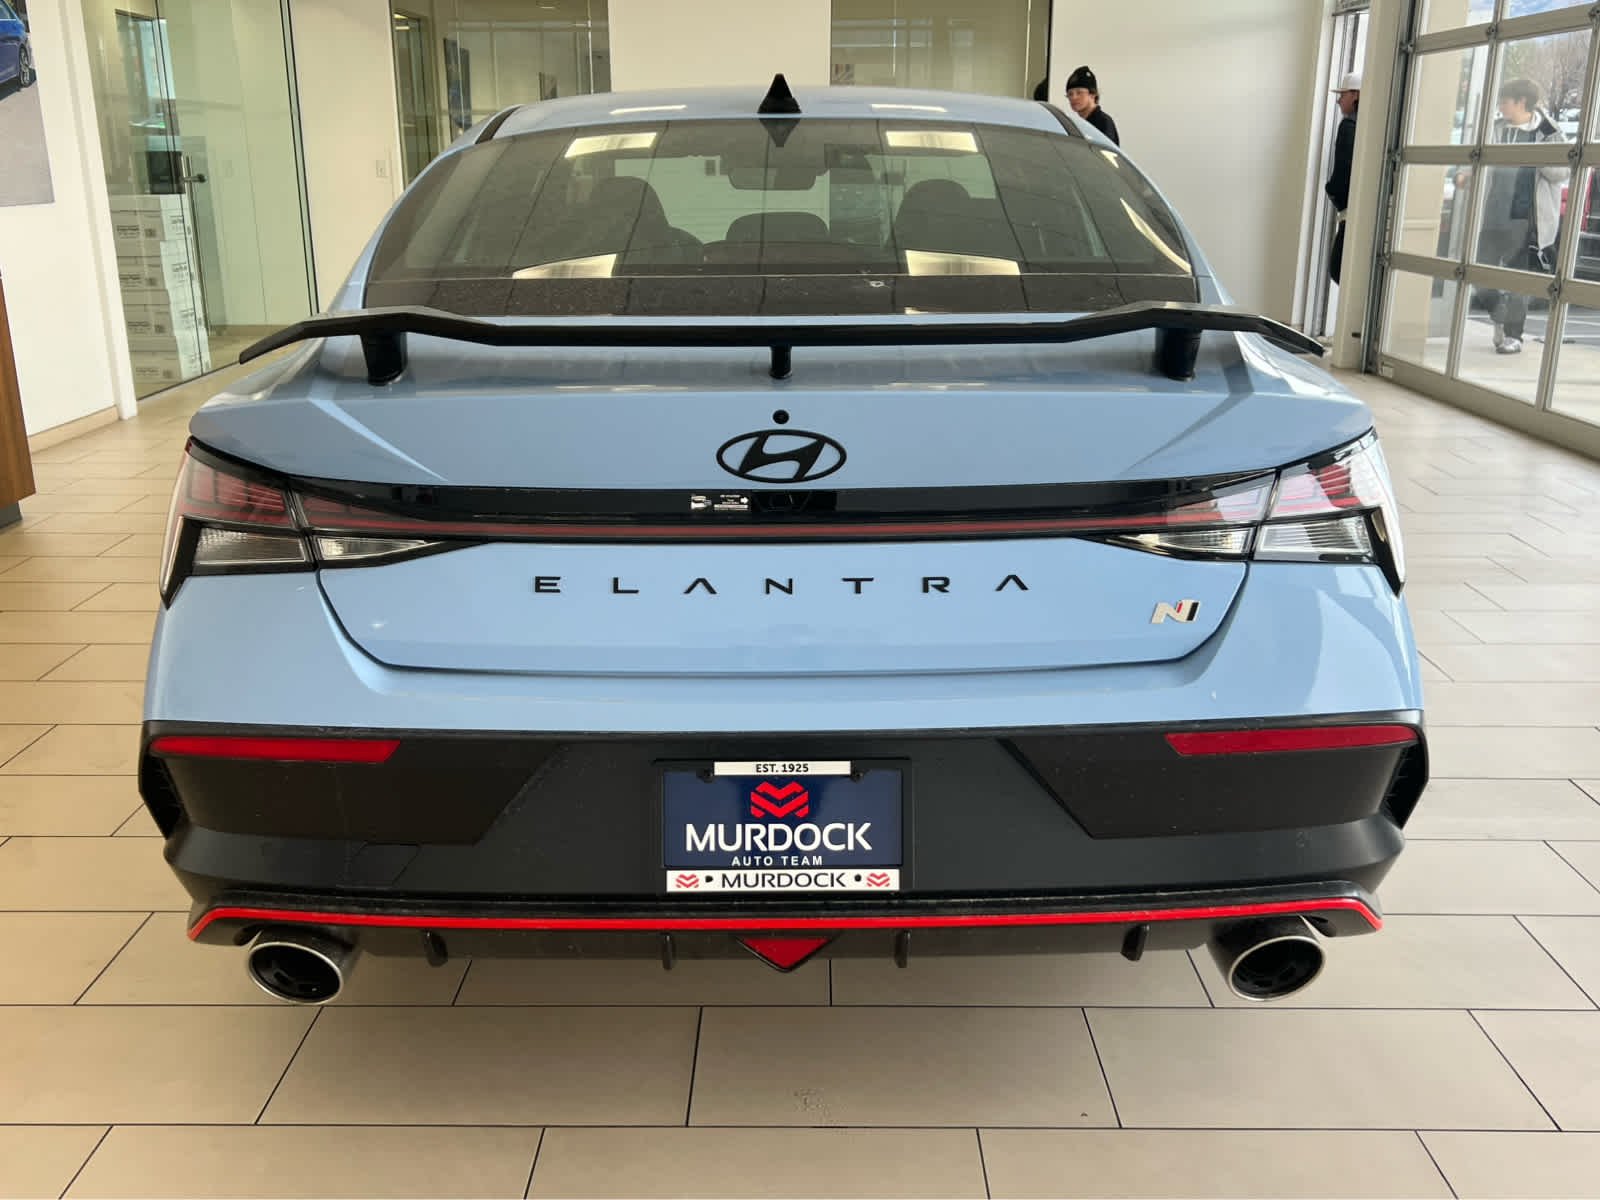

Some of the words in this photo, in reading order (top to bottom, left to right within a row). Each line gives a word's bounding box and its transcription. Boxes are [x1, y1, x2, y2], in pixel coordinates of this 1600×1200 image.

[534, 574, 1030, 596] ELANTRA
[755, 763, 779, 773] EST.
[781, 763, 809, 773] 1925
[685, 823, 872, 852] MURDOCK
[731, 855, 773, 867] AUTO
[781, 855, 823, 867] TEAM
[721, 872, 847, 888] MURDOCK
